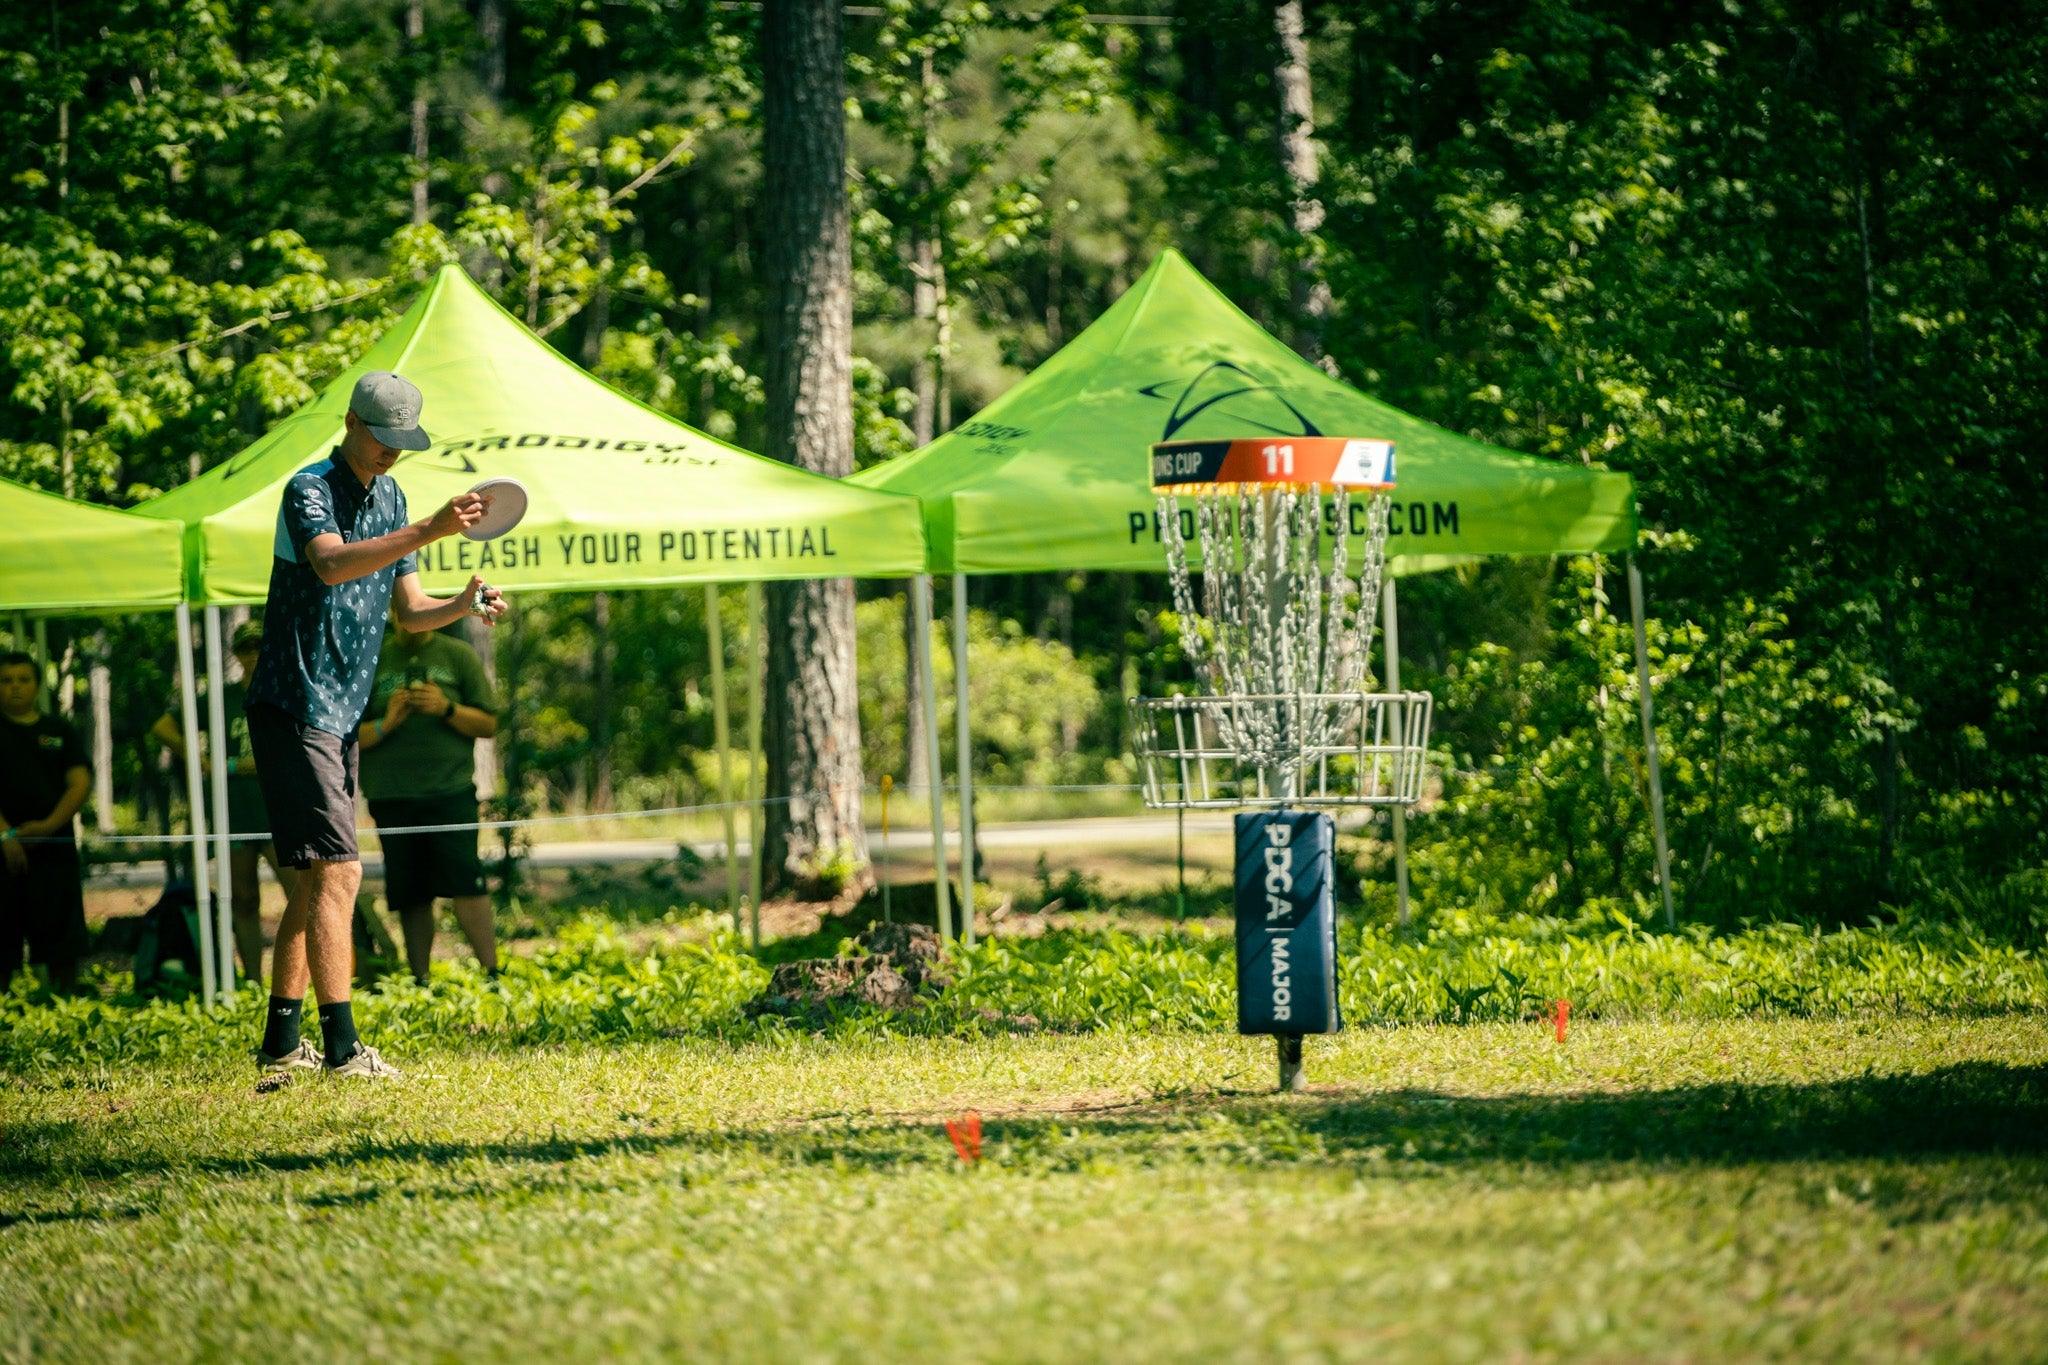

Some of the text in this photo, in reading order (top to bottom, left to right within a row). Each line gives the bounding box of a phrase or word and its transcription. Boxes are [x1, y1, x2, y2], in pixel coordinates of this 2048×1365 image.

[1175, 451, 1203, 475] CUP
[1262, 444, 1294, 476] 11
[415, 526, 837, 573] NLEASH YOUR POTENTIAL
[1264, 824, 1294, 1022] PDGA MAJOR
